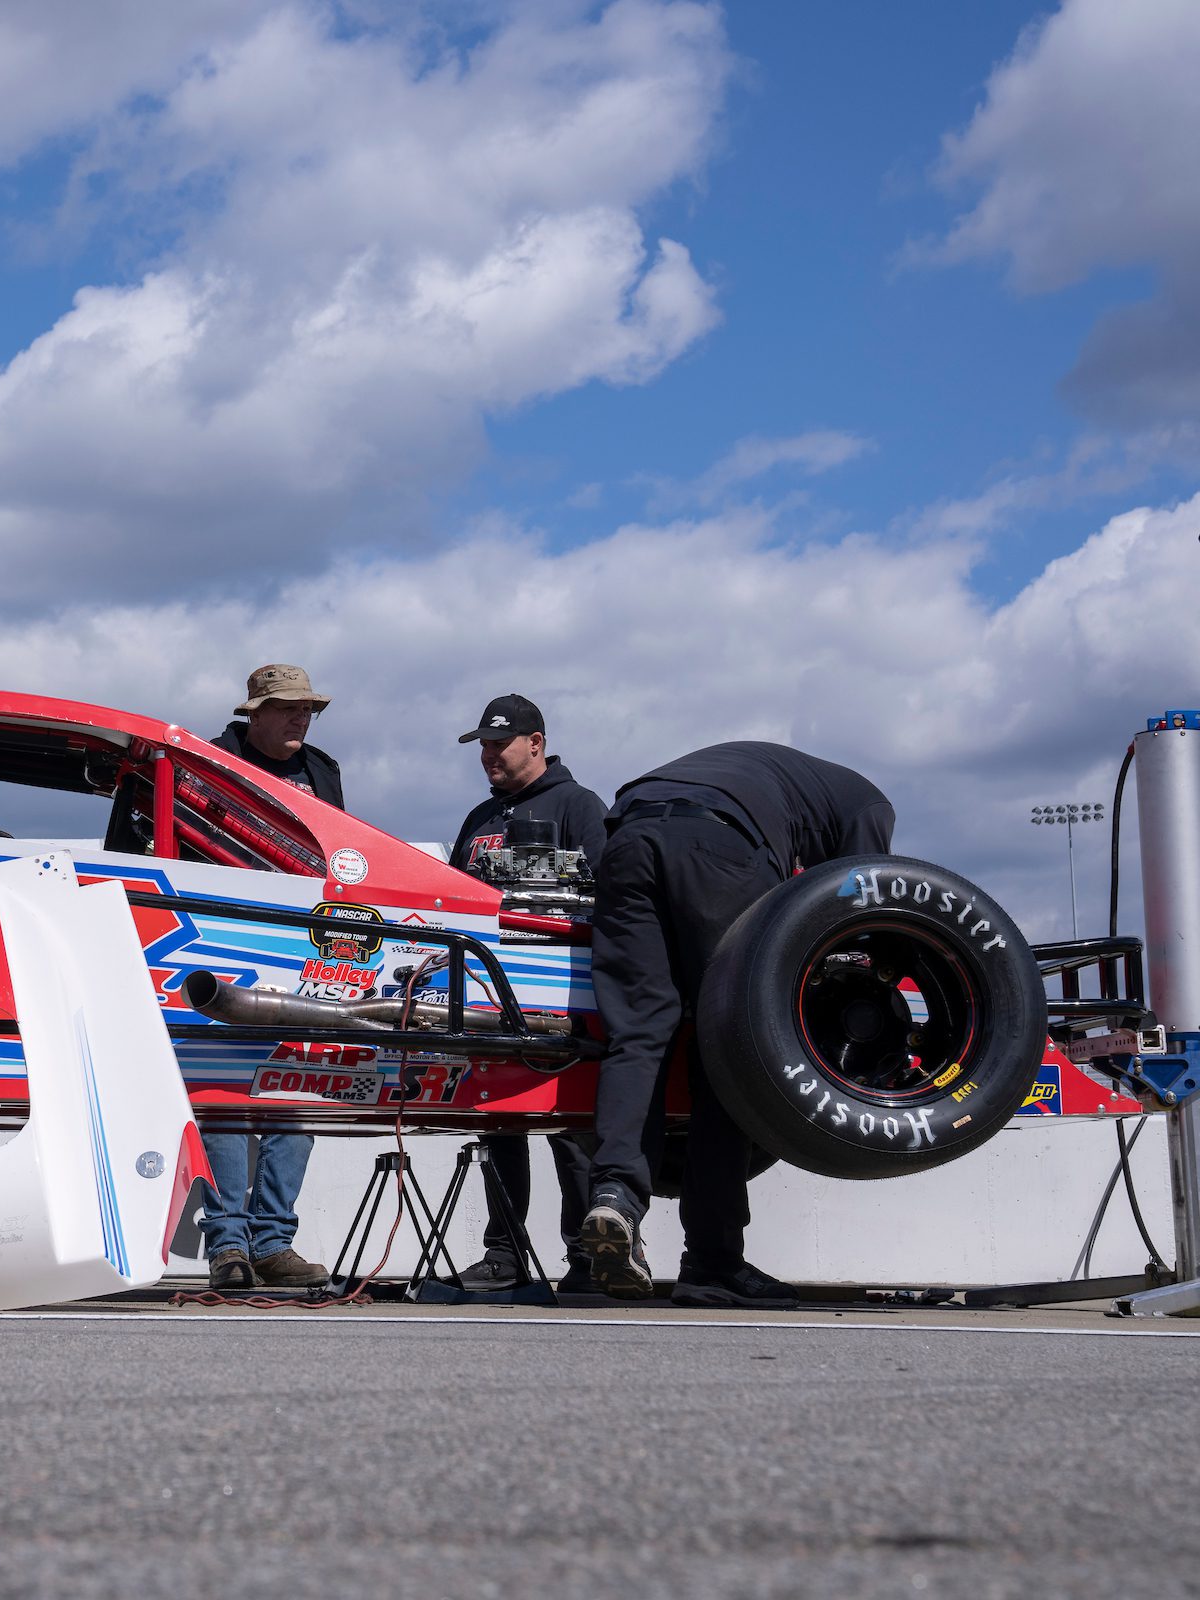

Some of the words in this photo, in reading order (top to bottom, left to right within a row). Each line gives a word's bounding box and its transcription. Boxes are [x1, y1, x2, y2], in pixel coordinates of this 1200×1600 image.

[334, 908, 373, 922] NASCAR
[853, 868, 1008, 952] Hoosier
[324, 931, 352, 940] MODIFIED
[353, 934, 369, 942] TOUR
[300, 959, 379, 990] Holley
[299, 981, 367, 1001] MSD
[268, 1041, 377, 1067] ARP
[259, 1070, 353, 1093] COMP
[936, 1064, 959, 1085] Bassett
[321, 1090, 367, 1101] CAMS
[783, 1062, 938, 1149] Hoosier
